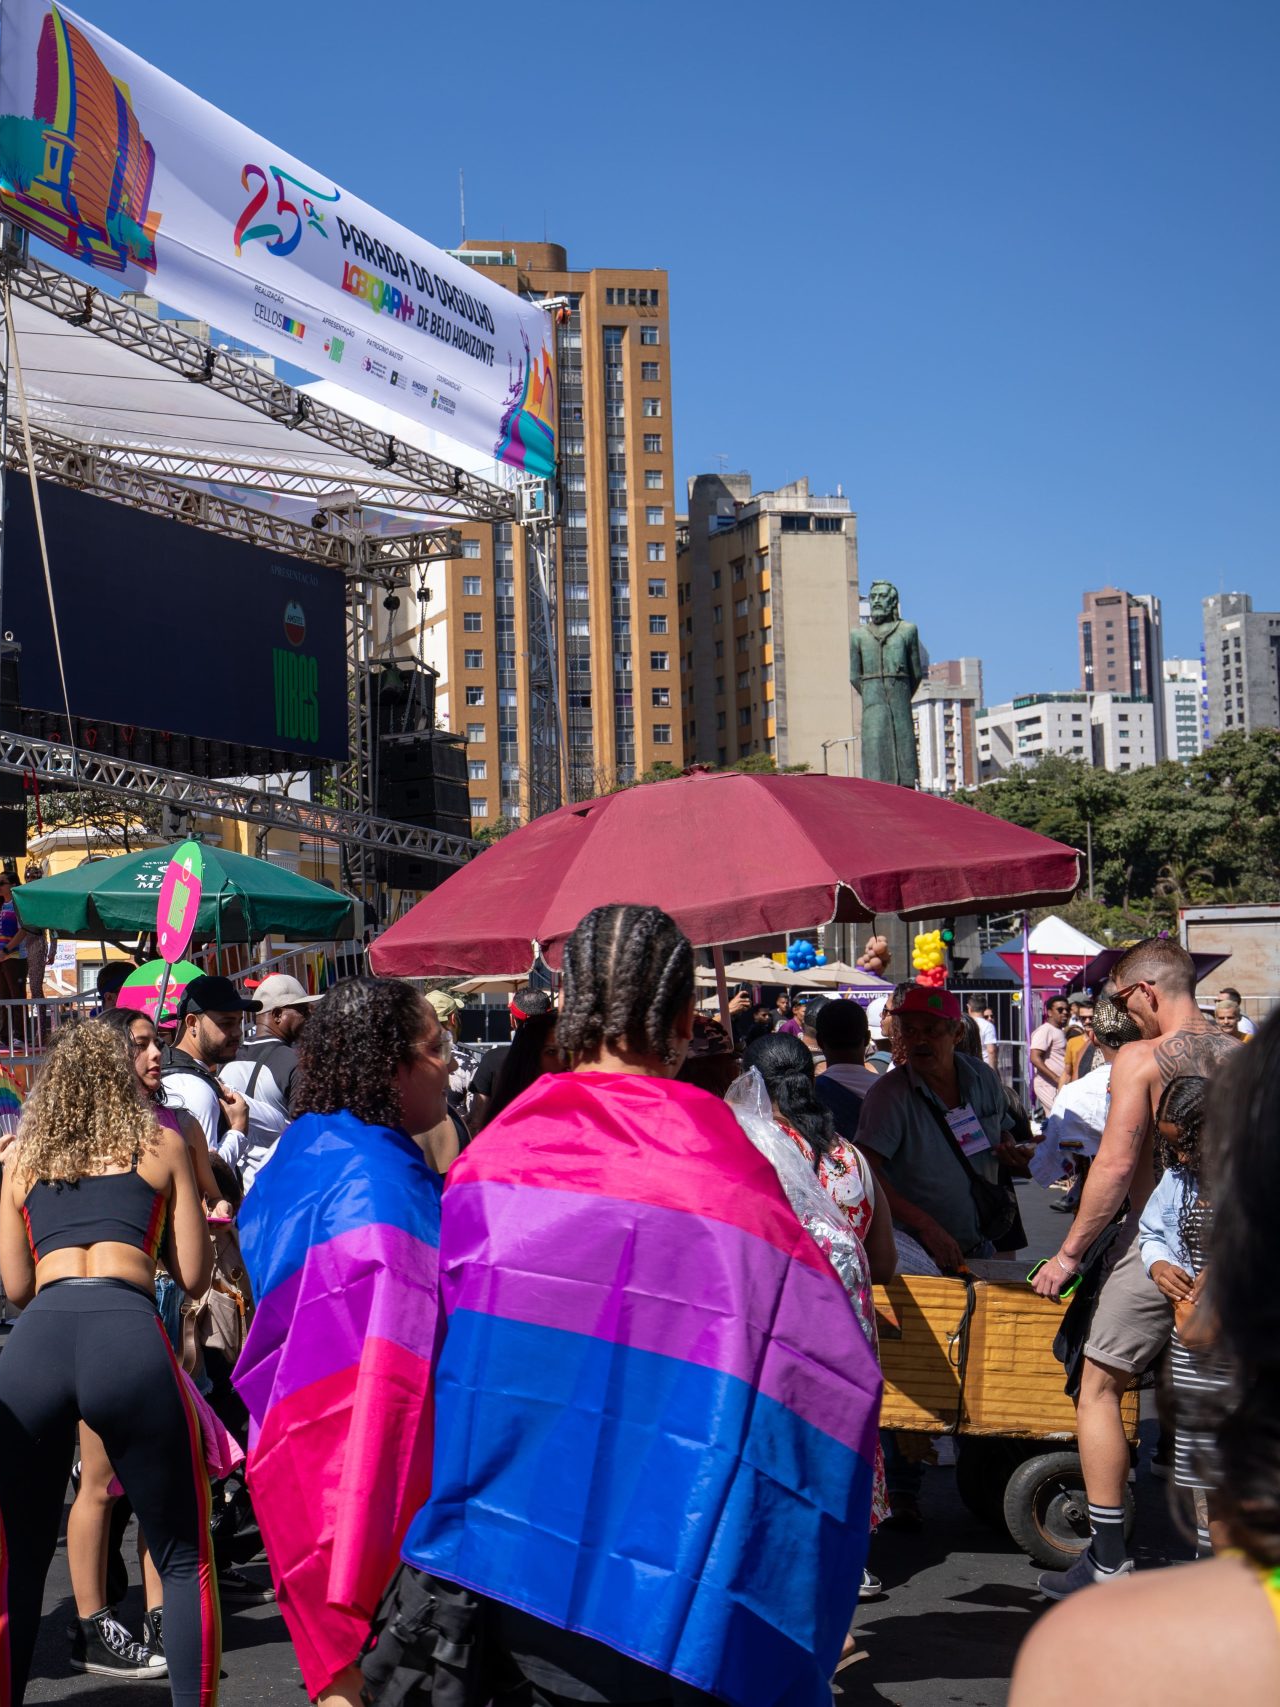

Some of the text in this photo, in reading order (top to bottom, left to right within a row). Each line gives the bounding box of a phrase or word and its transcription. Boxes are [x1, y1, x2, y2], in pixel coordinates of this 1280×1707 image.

[336, 216, 496, 336] PARADA DO ORGULHO
[254, 284, 285, 304] REALIZAÇÃO
[254, 302, 283, 328] CELLOS
[322, 317, 355, 338] APRESENTAÇÃO
[417, 305, 430, 333] DE
[430, 310, 452, 345] BELO
[452, 324, 496, 367] HORIZONTE
